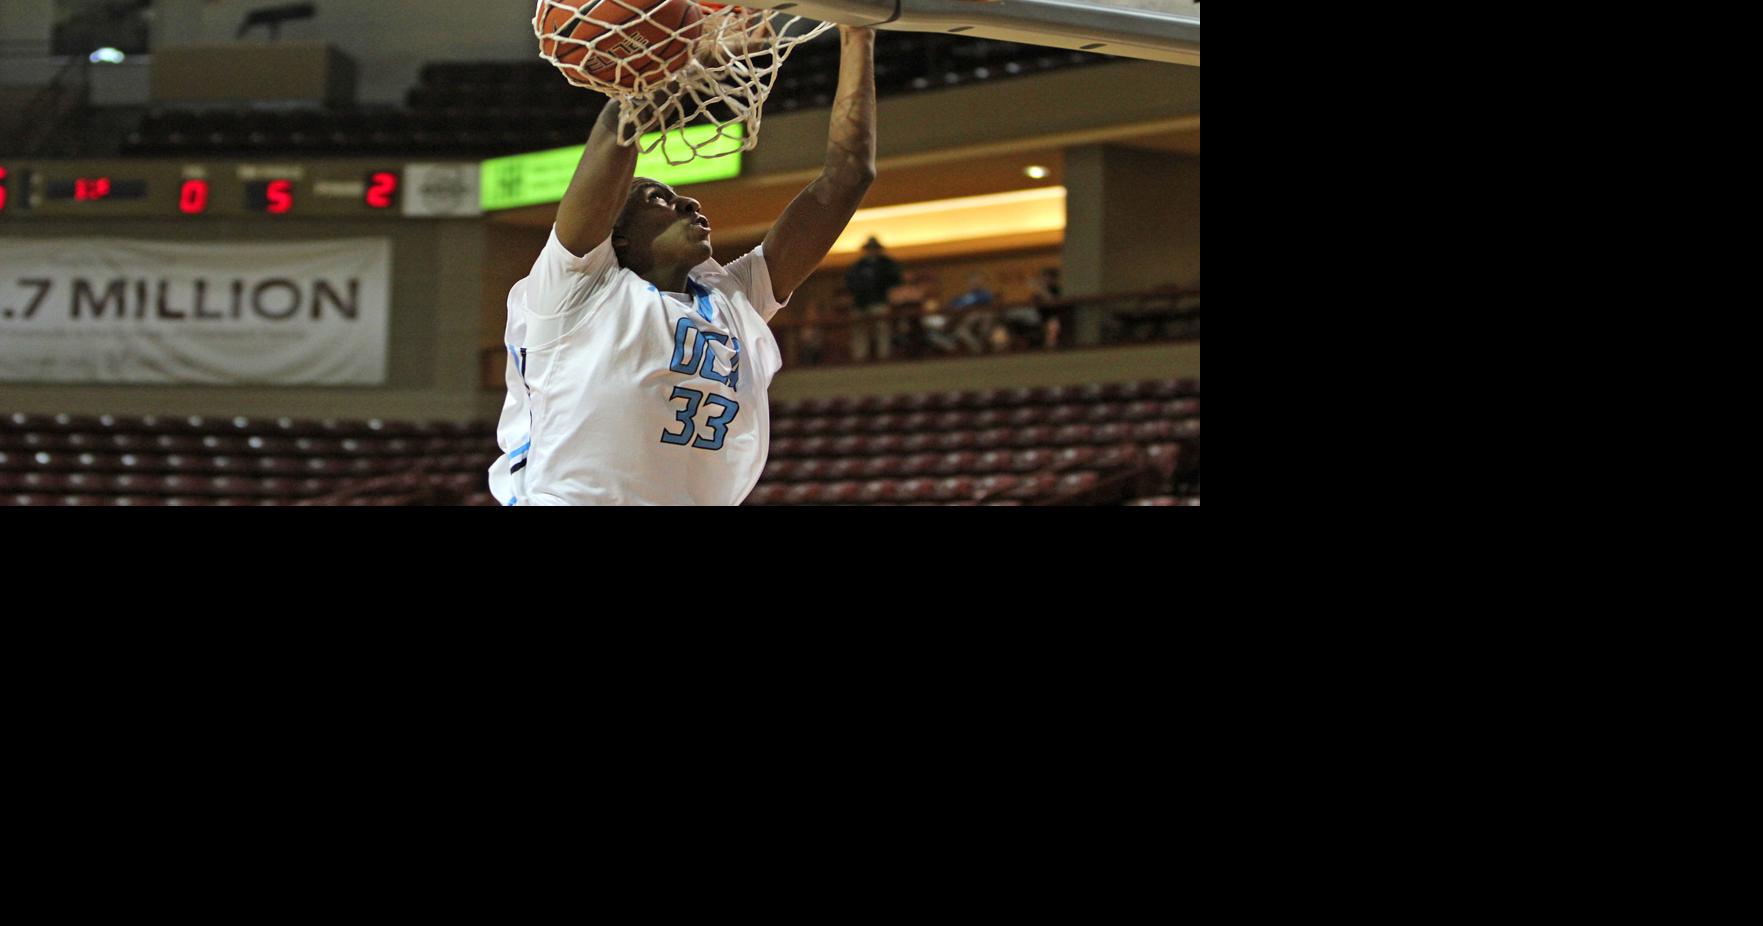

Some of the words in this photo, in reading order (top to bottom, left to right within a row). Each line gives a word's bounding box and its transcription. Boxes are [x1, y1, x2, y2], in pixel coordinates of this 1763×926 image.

[179, 179, 208, 214] 0
[366, 172, 397, 208] 2
[71, 278, 360, 321] MILLION
[660, 386, 740, 451] 33
